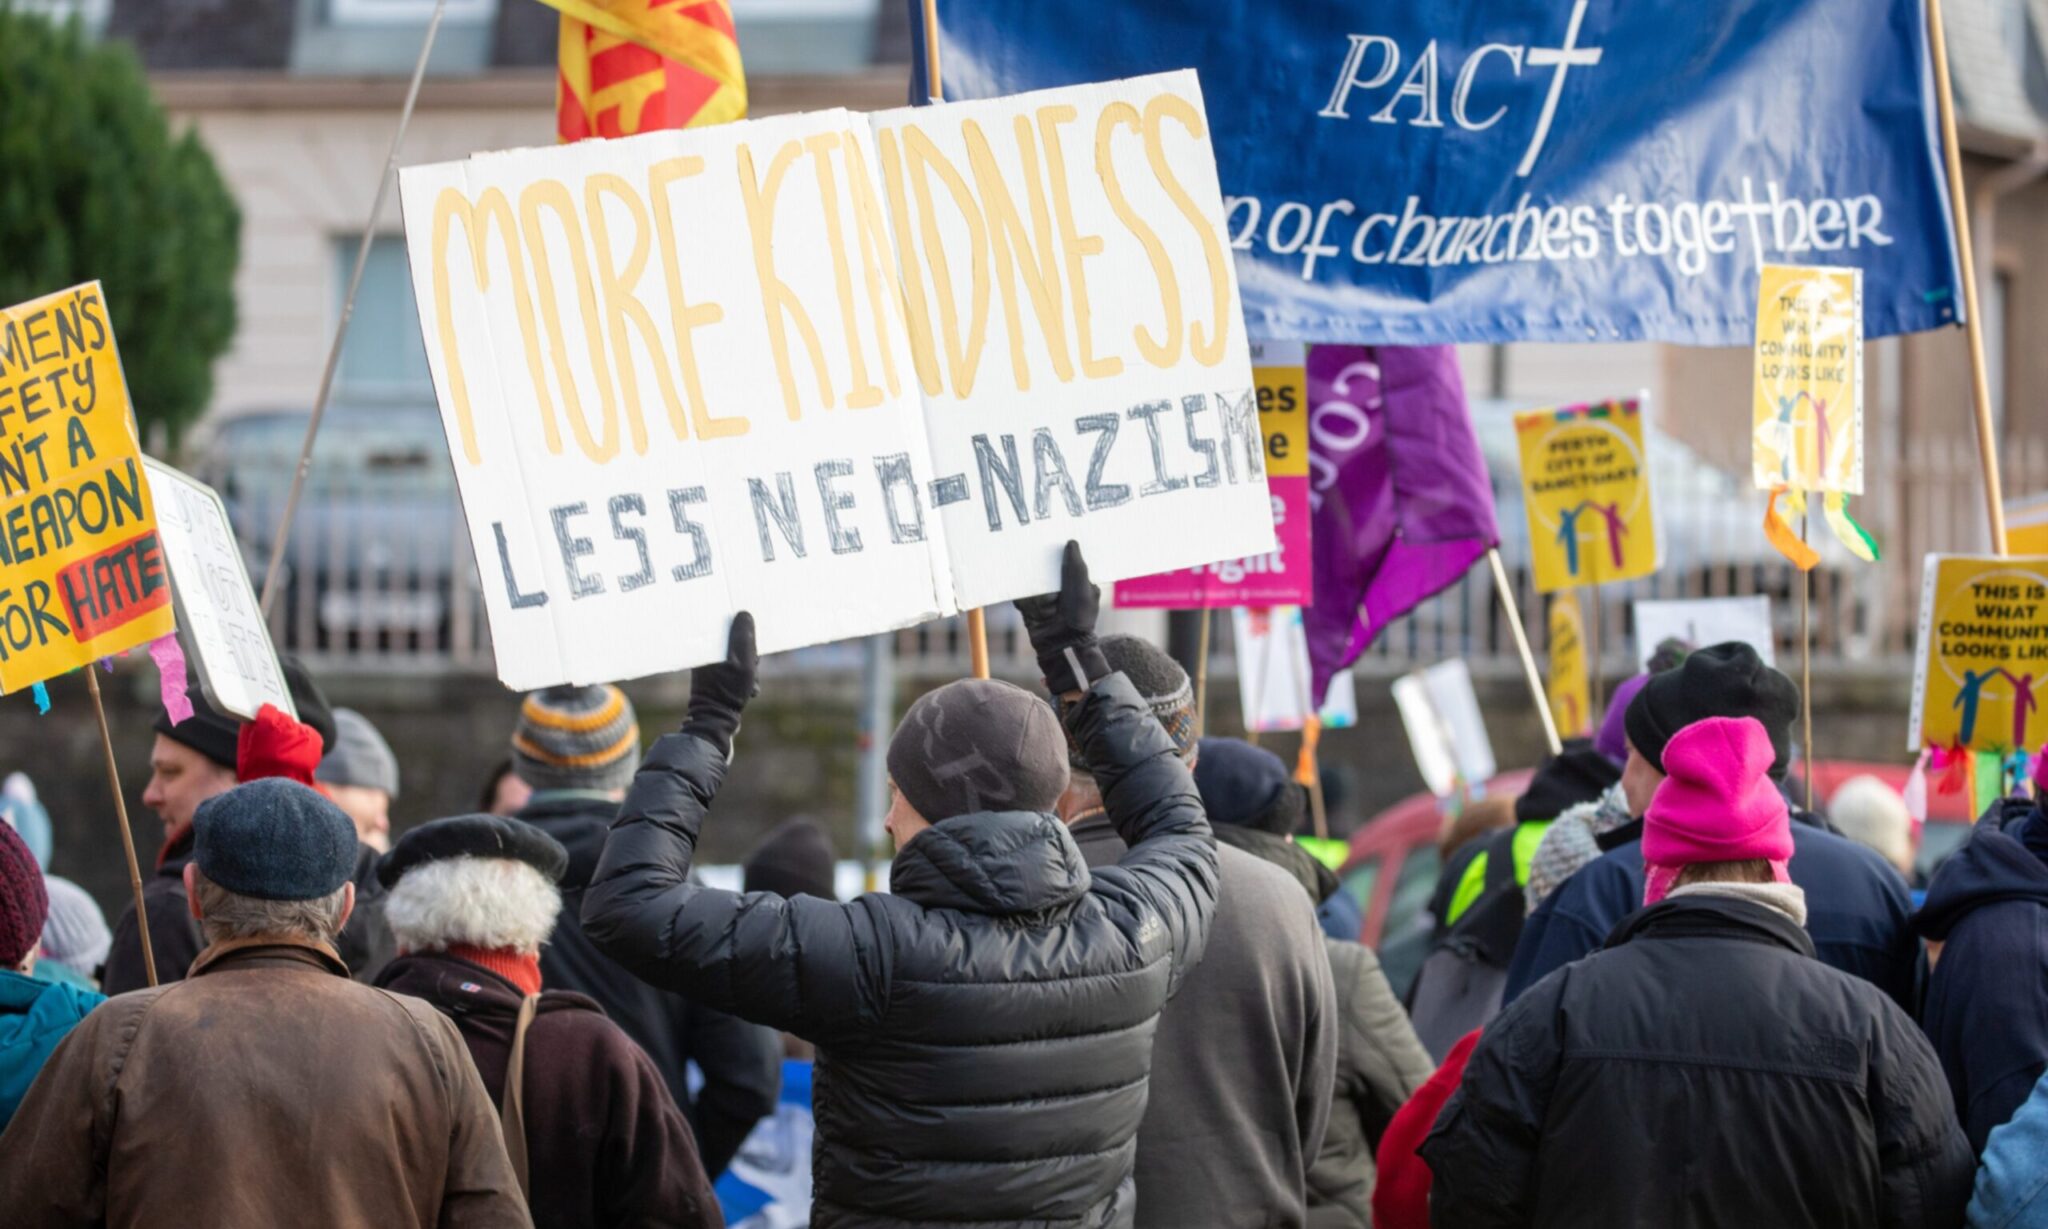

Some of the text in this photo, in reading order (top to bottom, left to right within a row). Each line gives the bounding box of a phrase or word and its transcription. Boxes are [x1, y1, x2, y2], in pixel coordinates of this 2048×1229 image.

[1267, 199, 1355, 281] of
[1352, 193, 1599, 267] churches
[1607, 176, 1894, 276] together
[432, 93, 1230, 465] MORE KINDNESS
[1782, 319, 1823, 335] WH
[66, 416, 96, 468] A
[0, 457, 144, 566] EAPON
[492, 387, 1266, 610] LESS NEO-NAZISM
[62, 534, 164, 629] HATE
[1972, 582, 2046, 600] THIS IS
[1976, 603, 2038, 620] WHAT
[1941, 641, 2010, 661] LOOKS
